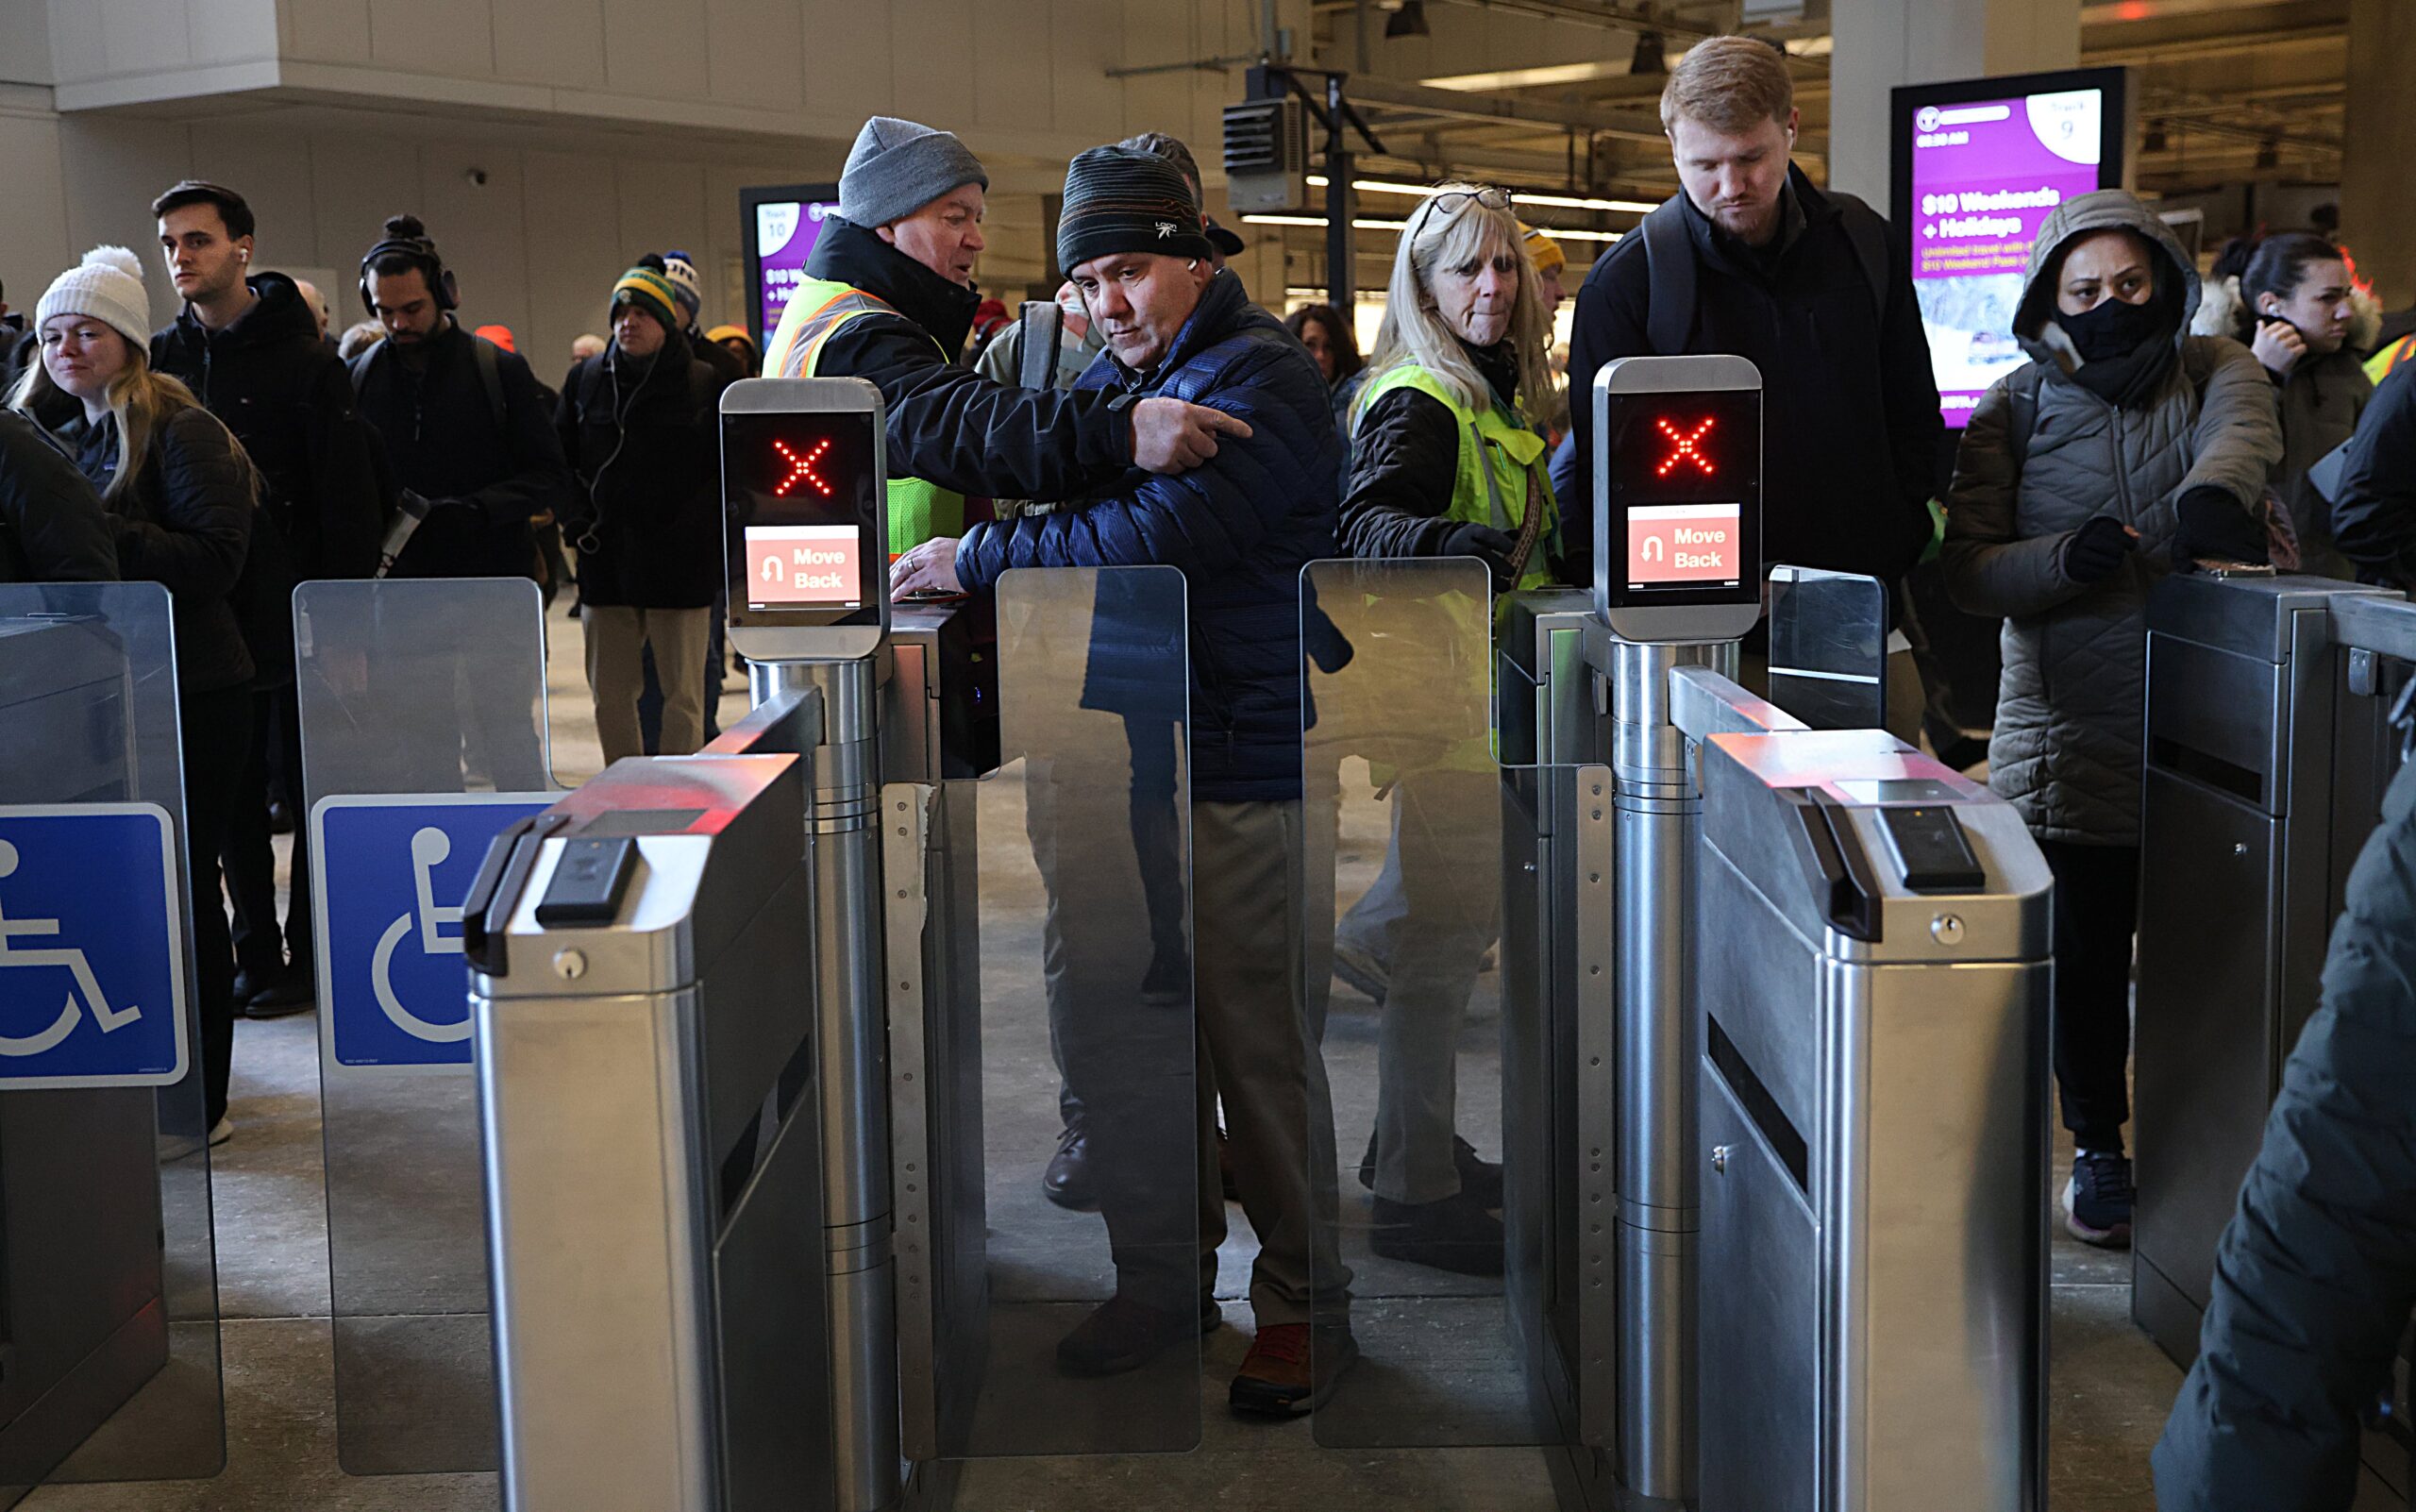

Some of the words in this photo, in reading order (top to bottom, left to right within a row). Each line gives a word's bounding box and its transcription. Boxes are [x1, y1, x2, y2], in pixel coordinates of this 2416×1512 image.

[2061, 120, 2073, 140] 9
[1921, 193, 1959, 216] $10
[1959, 186, 2060, 211] Weekends
[769, 223, 786, 237] 10
[1939, 215, 2022, 239] Holidays
[1674, 528, 1726, 545] Move
[793, 548, 846, 565] Move
[1674, 551, 1723, 569] Back
[794, 571, 844, 590] Back
